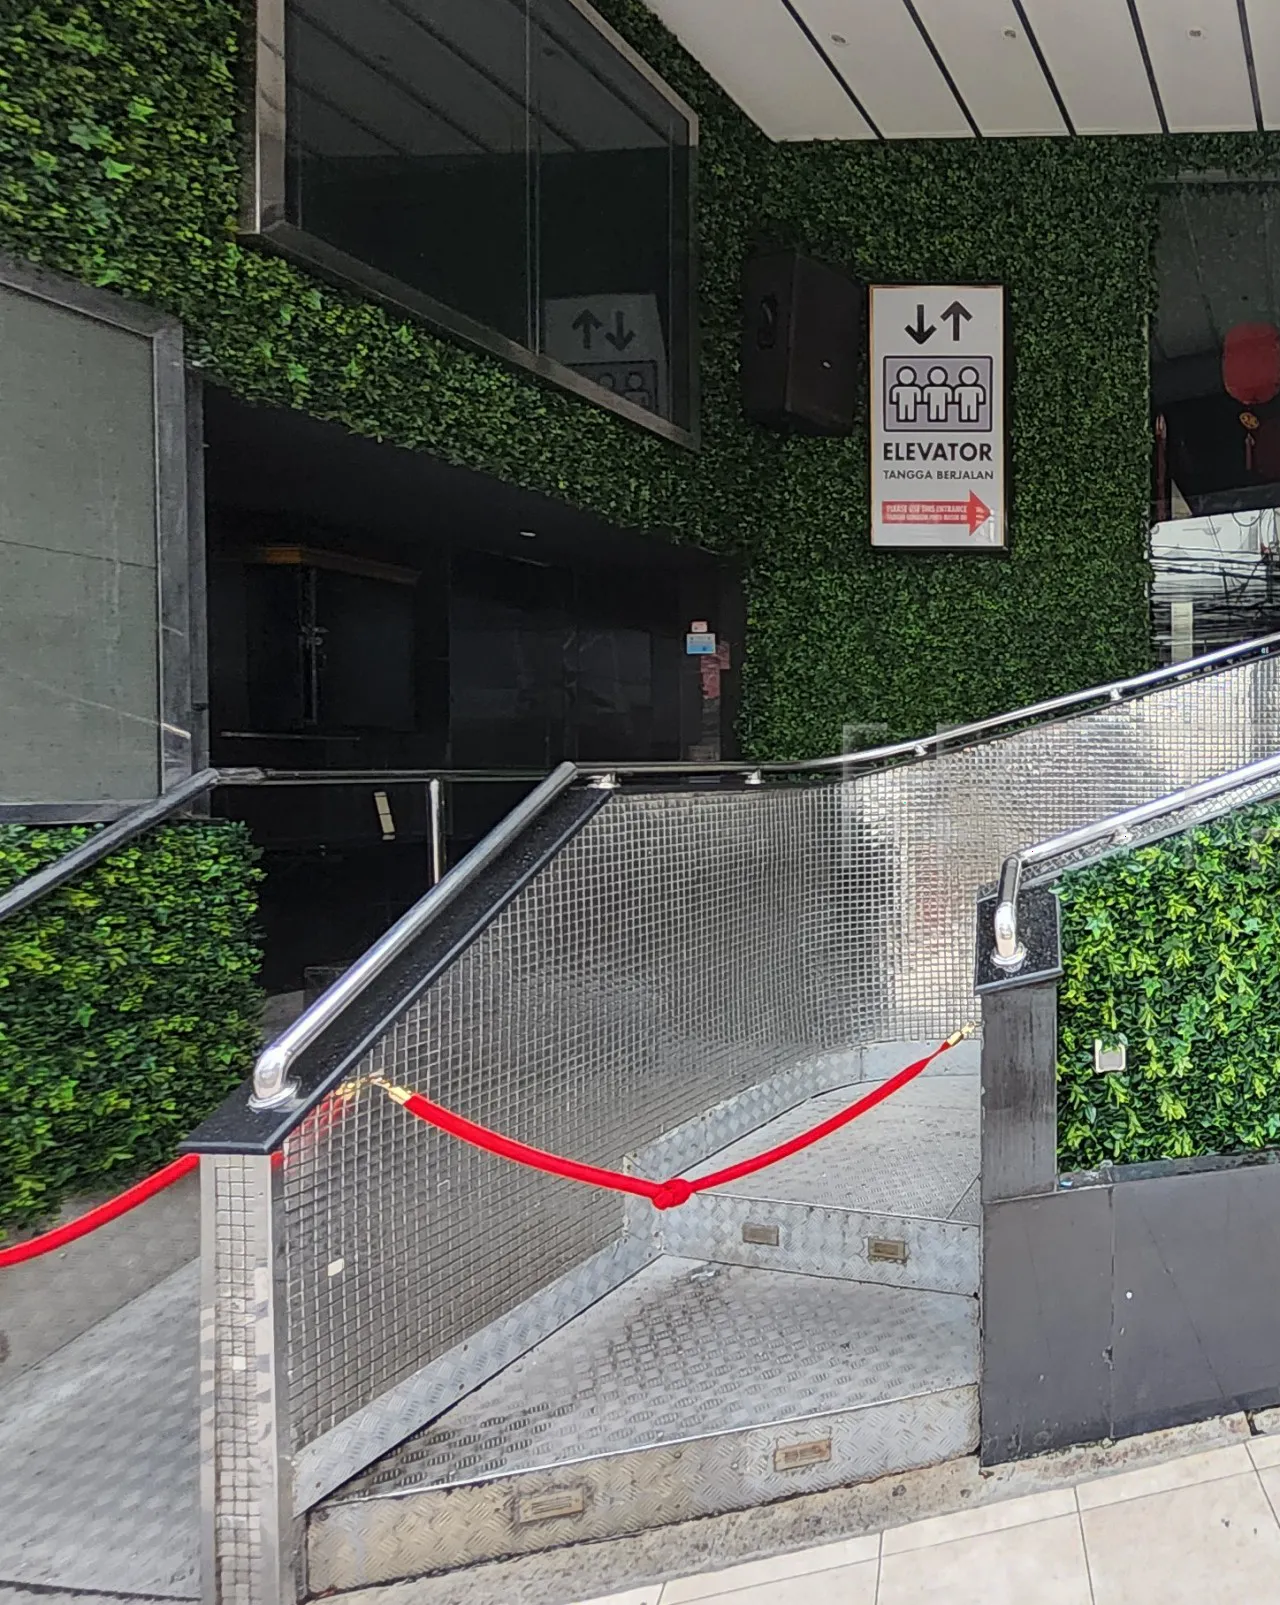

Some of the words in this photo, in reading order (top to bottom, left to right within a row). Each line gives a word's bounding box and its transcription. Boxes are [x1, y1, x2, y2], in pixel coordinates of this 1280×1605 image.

[883, 442, 993, 462] ELEVATOR
[883, 469, 933, 480] TANGGA
[936, 470, 994, 480] BERJALAN
